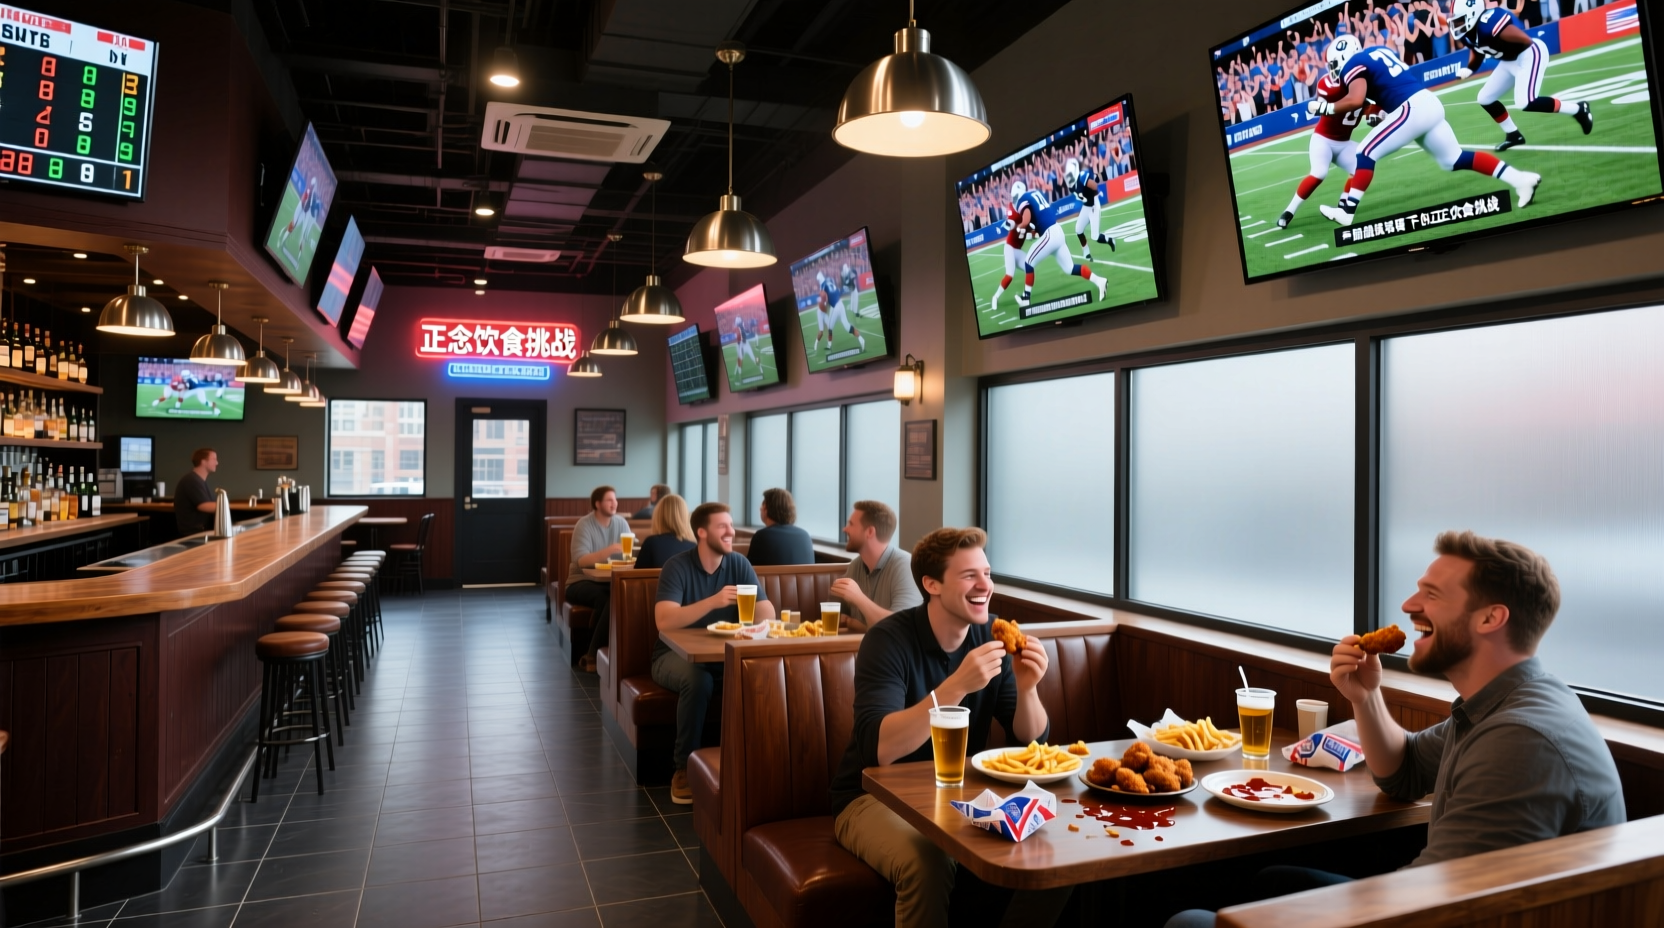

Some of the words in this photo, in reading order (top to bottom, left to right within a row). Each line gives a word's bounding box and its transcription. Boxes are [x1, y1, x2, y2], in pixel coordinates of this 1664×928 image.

[122, 170, 132, 190] 1
[420, 324, 577, 359] 正念饮食挑战
